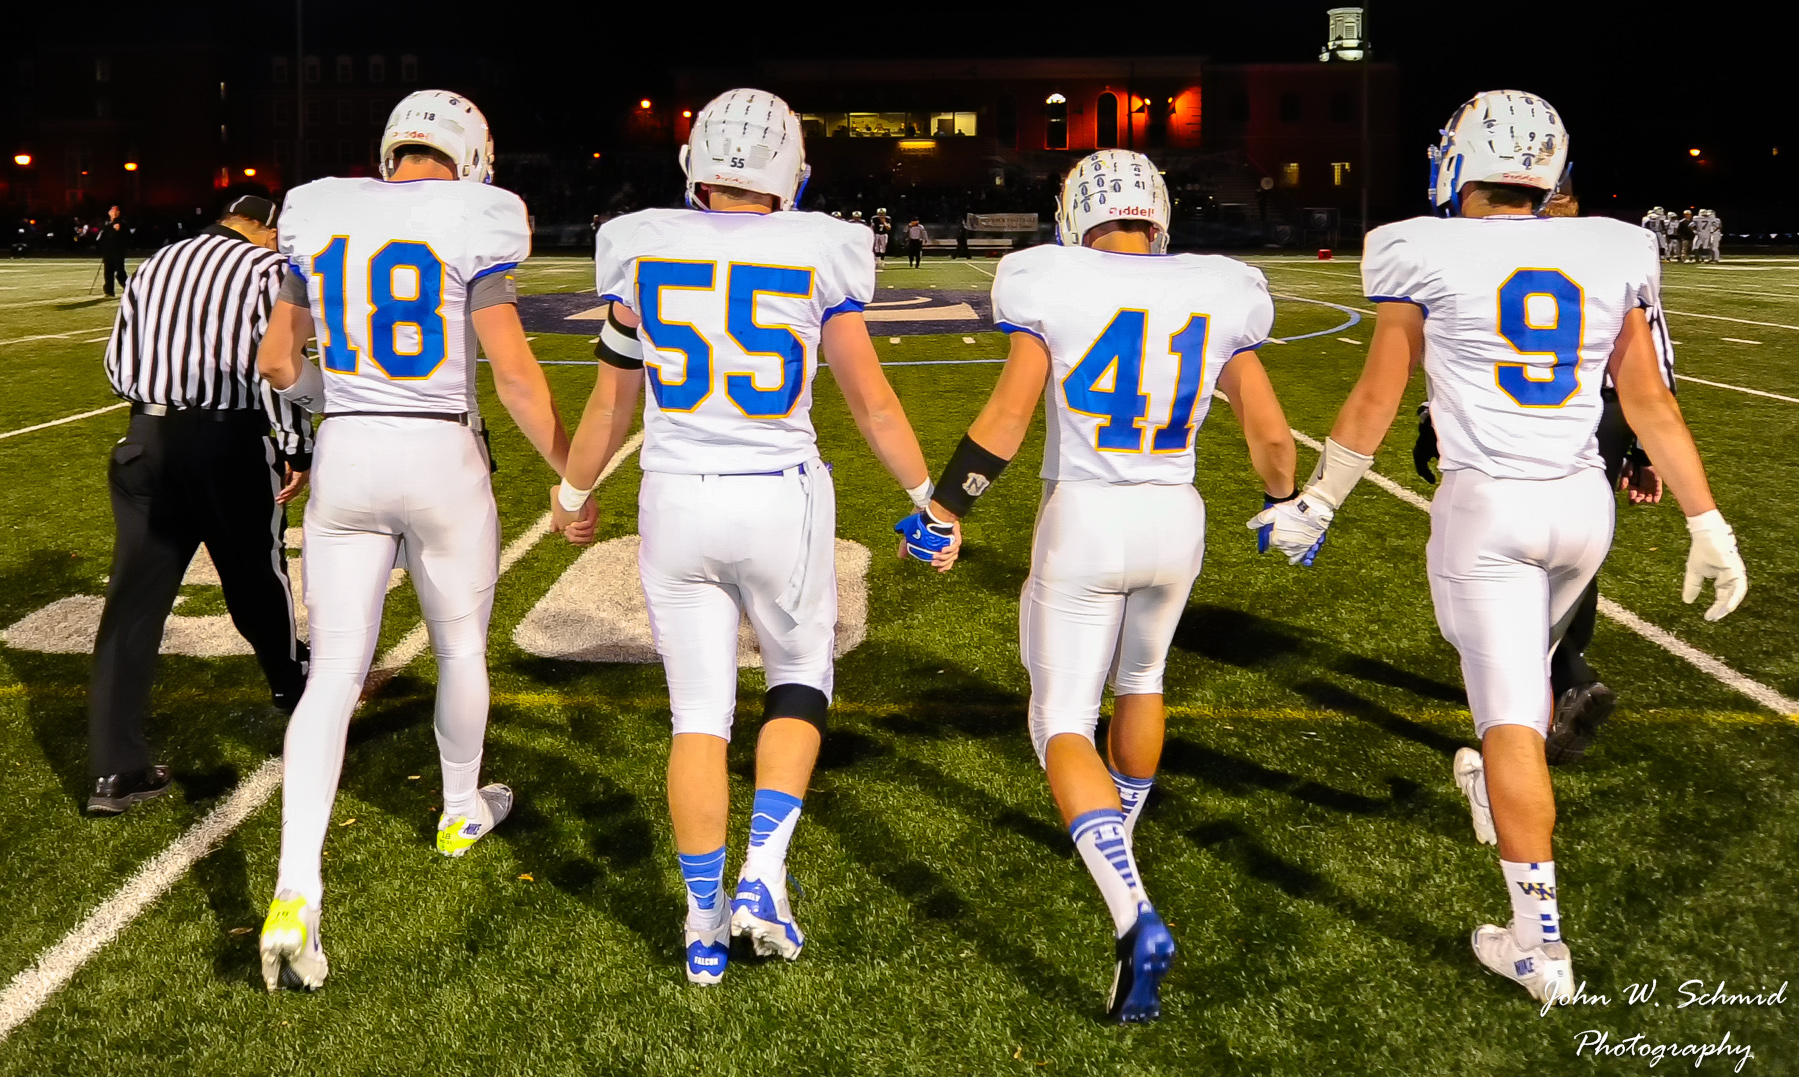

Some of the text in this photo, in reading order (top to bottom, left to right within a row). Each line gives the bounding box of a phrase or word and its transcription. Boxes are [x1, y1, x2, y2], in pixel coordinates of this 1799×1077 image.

[424, 111, 436, 121] 18
[1529, 131, 1537, 142] 9
[730, 156, 745, 169] 55
[1134, 180, 1146, 191] 41
[311, 235, 448, 381] 18
[634, 257, 816, 420] 55
[1494, 267, 1586, 409] 9
[1060, 307, 1211, 455] 41
